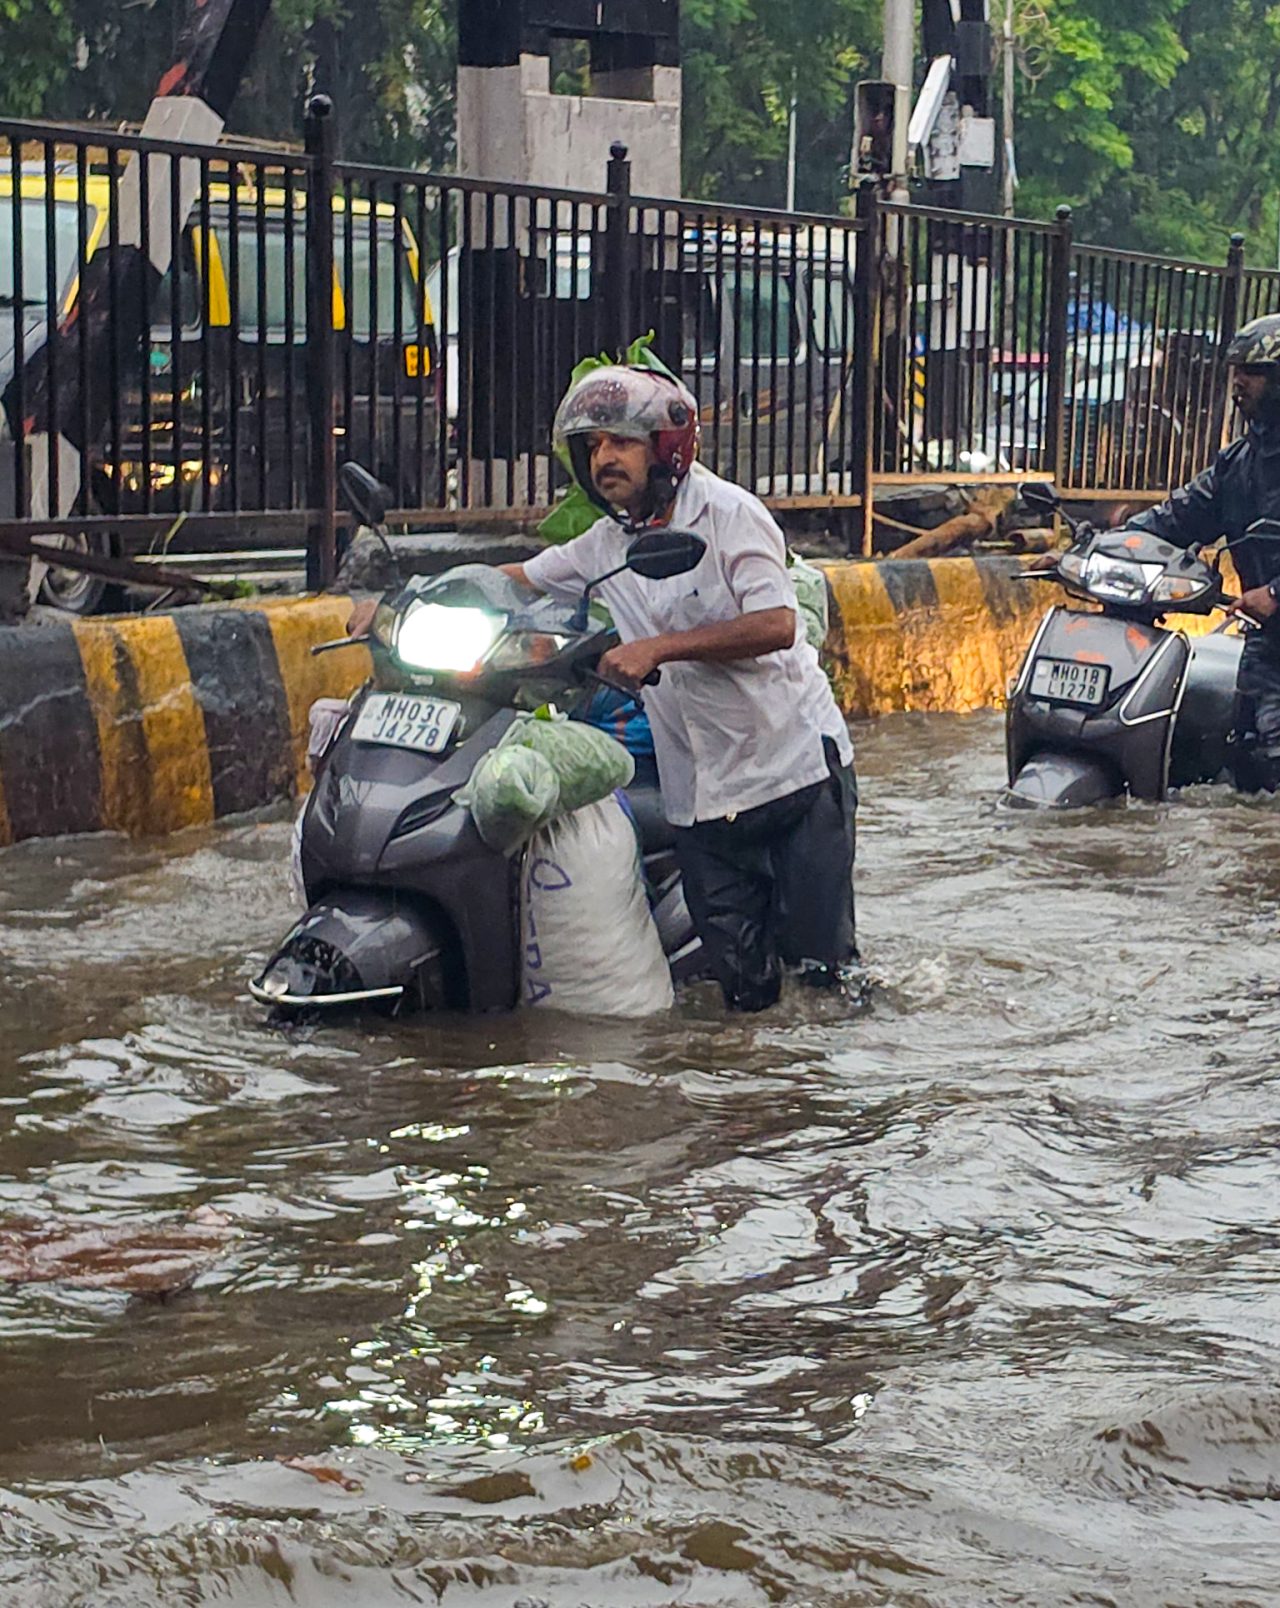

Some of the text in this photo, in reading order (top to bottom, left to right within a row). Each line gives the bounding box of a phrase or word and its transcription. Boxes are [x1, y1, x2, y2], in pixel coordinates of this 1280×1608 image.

[1047, 681, 1096, 701] L1278
[381, 696, 447, 726] MH03C
[372, 719, 439, 747] J4278
